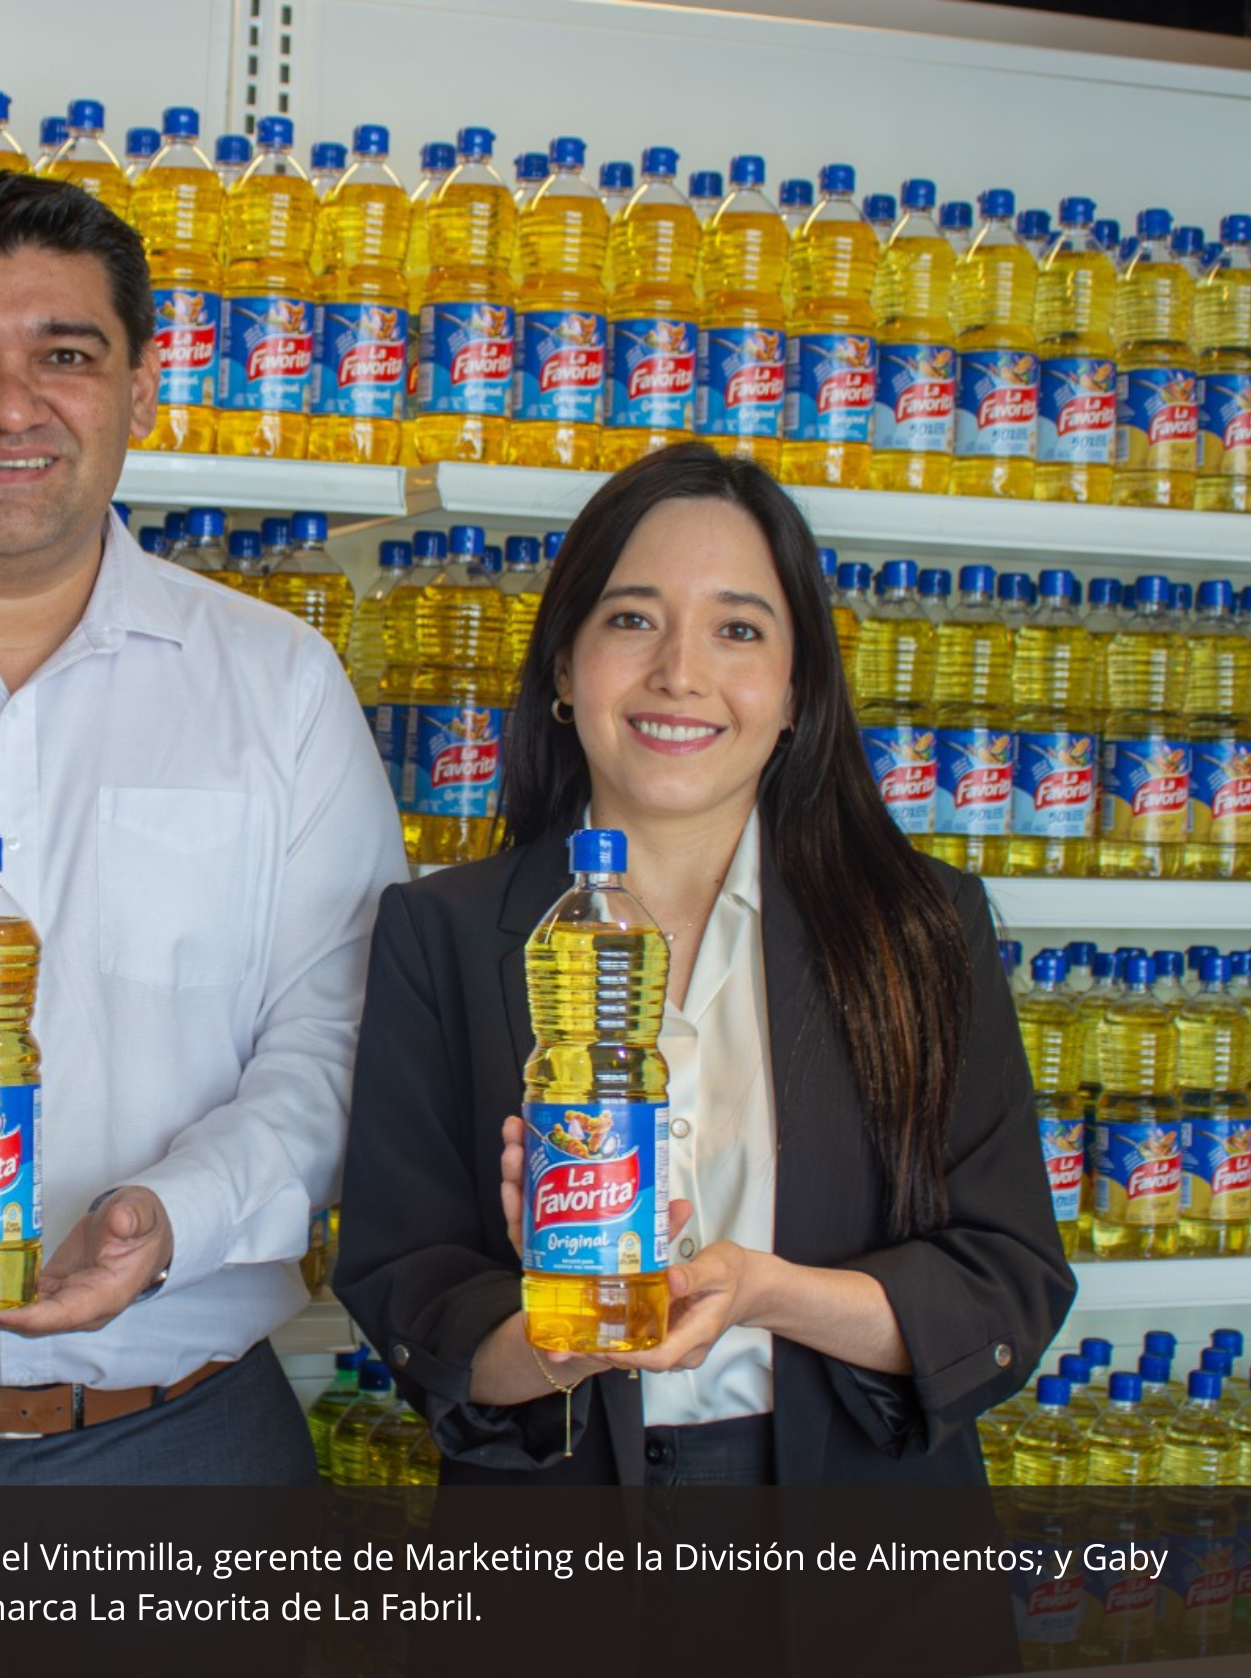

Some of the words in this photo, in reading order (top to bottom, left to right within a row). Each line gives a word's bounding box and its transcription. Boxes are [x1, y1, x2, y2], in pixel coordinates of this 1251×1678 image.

[174, 332, 192, 348] La
[277, 340, 297, 354] La
[158, 342, 212, 364] avorita
[369, 347, 386, 361] La
[481, 343, 498, 357] La
[249, 350, 311, 377] Favorita
[570, 353, 588, 367] La
[657, 359, 676, 373] La
[340, 356, 402, 383] Favorita
[755, 368, 771, 380] La
[847, 374, 862, 387] La
[924, 384, 940, 397] La
[1006, 388, 1023, 402] La
[1085, 399, 1101, 411] La
[1175, 408, 1189, 420] La
[461, 746, 479, 759] La
[434, 757, 496, 782] Favorita
[907, 768, 921, 780] La
[983, 771, 998, 783] La
[1063, 775, 1078, 786] La
[1159, 780, 1174, 792] La
[1213, 792, 1251, 816] Favor
[1153, 1162, 1168, 1174] La
[1236, 1158, 1249, 1169] La
[568, 1168, 595, 1188] La
[535, 1182, 634, 1222] Favorita
[548, 1232, 610, 1259] Original
